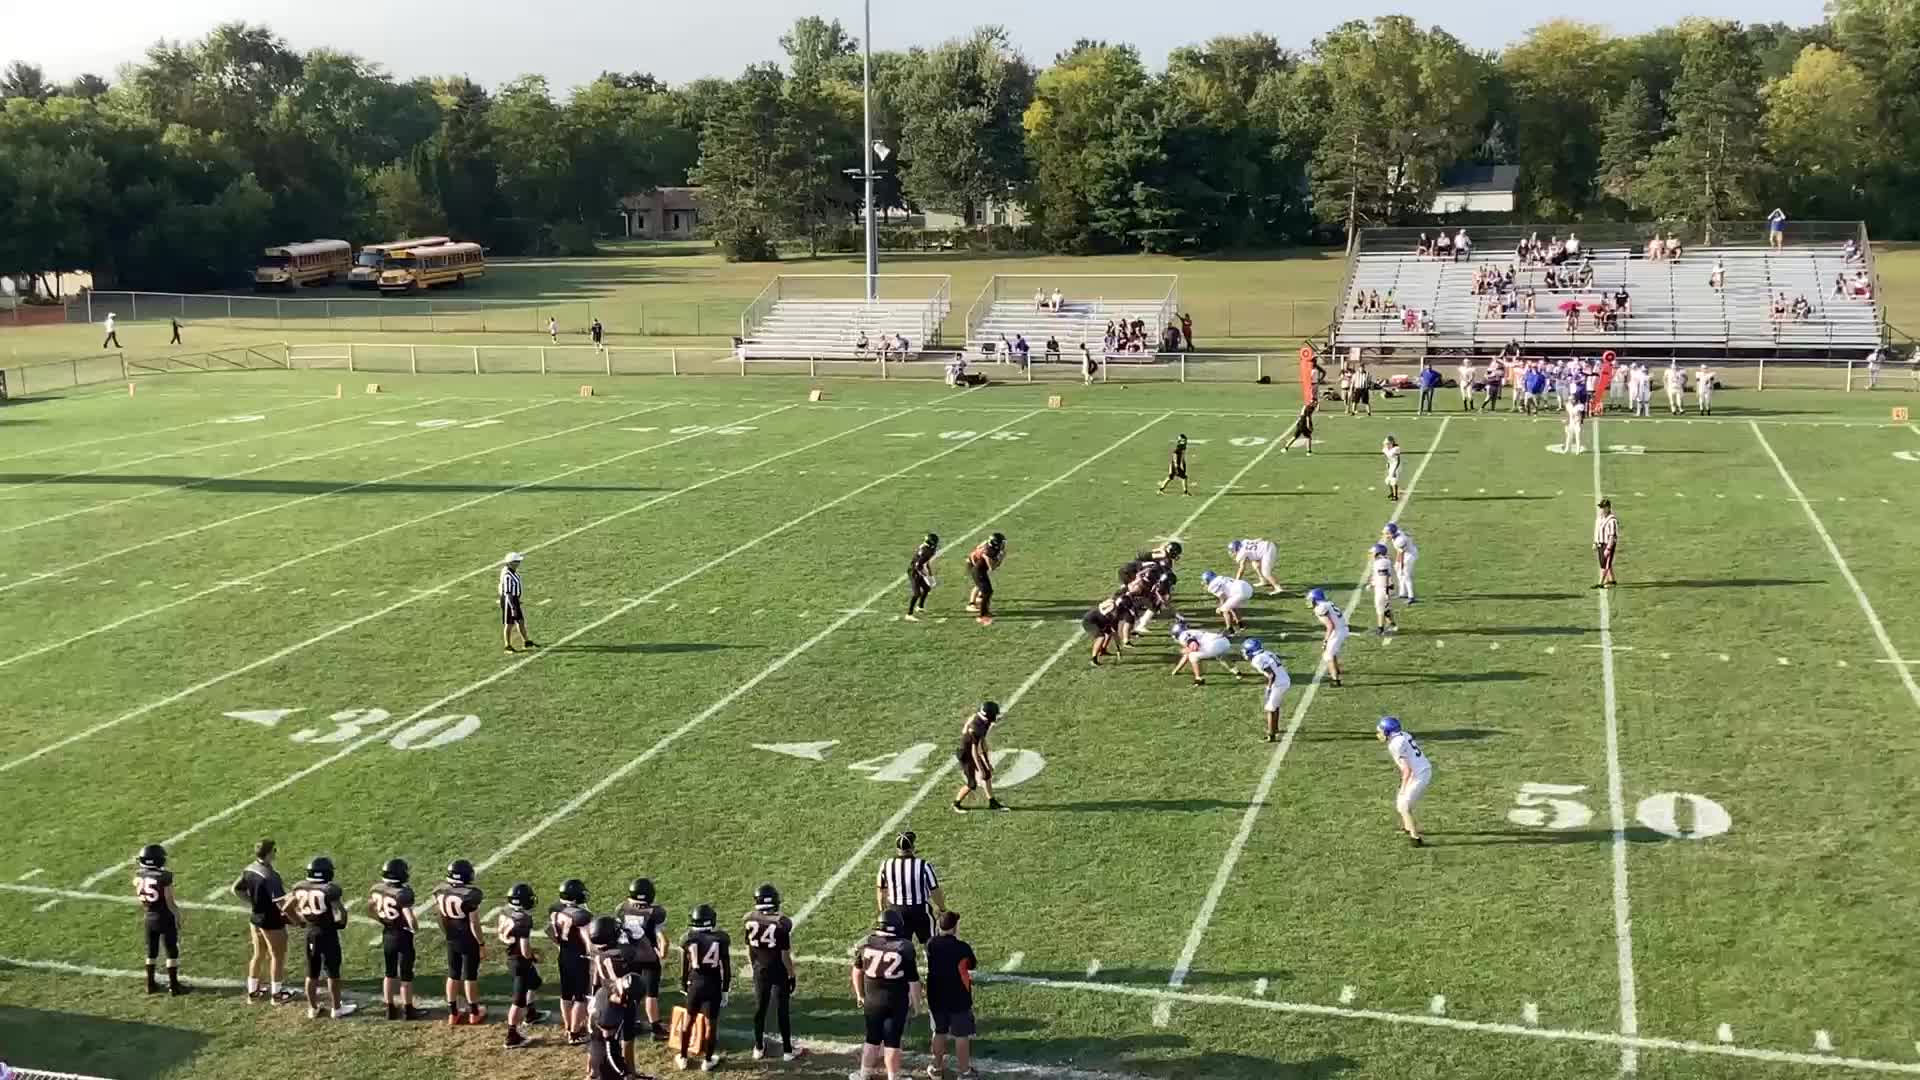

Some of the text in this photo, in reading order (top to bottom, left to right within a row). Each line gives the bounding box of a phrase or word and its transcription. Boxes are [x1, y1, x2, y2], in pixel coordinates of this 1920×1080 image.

[288, 707, 482, 750] 30
[848, 743, 1047, 788] 40
[1507, 782, 1733, 840] 50
[295, 889, 327, 915] 20
[745, 921, 777, 949] 24
[688, 941, 720, 969] 14
[863, 947, 905, 979] 72
